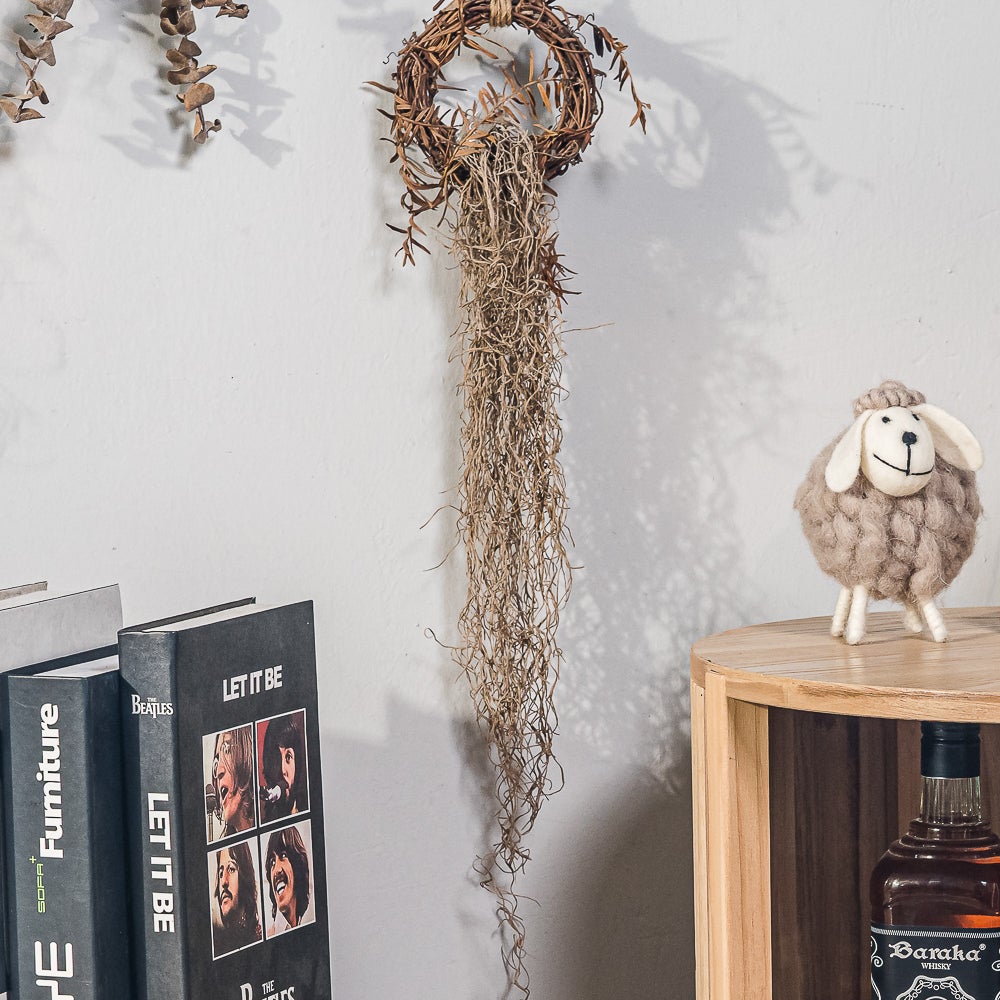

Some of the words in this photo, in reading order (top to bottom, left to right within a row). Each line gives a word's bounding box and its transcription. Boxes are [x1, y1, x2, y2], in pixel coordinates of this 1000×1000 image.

[223, 673, 248, 702] LET
[249, 669, 263, 695] IT
[264, 664, 283, 691] BE
[131, 694, 174, 719] BEATLES
[36, 703, 64, 859] Furniture
[147, 792, 172, 851] LET
[150, 856, 173, 887] IT
[152, 892, 175, 933] BE
[921, 962, 952, 970] WHISKY
[261, 979, 275, 995] THE
